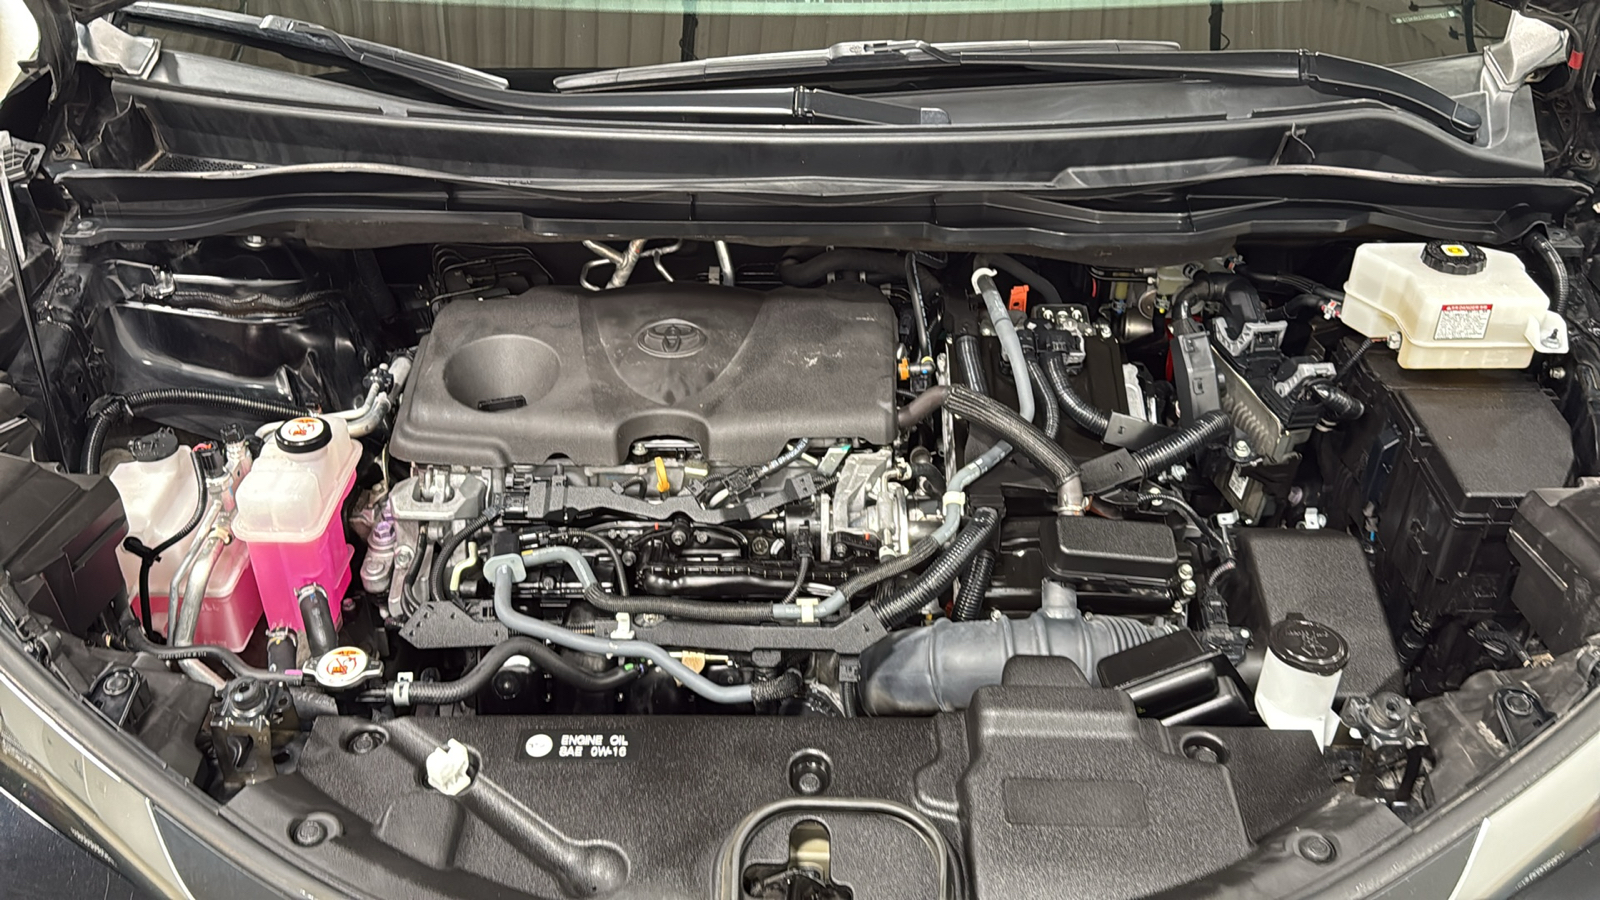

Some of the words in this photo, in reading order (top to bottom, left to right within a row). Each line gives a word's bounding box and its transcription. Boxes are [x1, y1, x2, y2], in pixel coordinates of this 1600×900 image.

[561, 734, 603, 746] ENGINE
[609, 734, 628, 746] OIL
[559, 746, 583, 757] SAE
[590, 746, 627, 757] 0W-16
